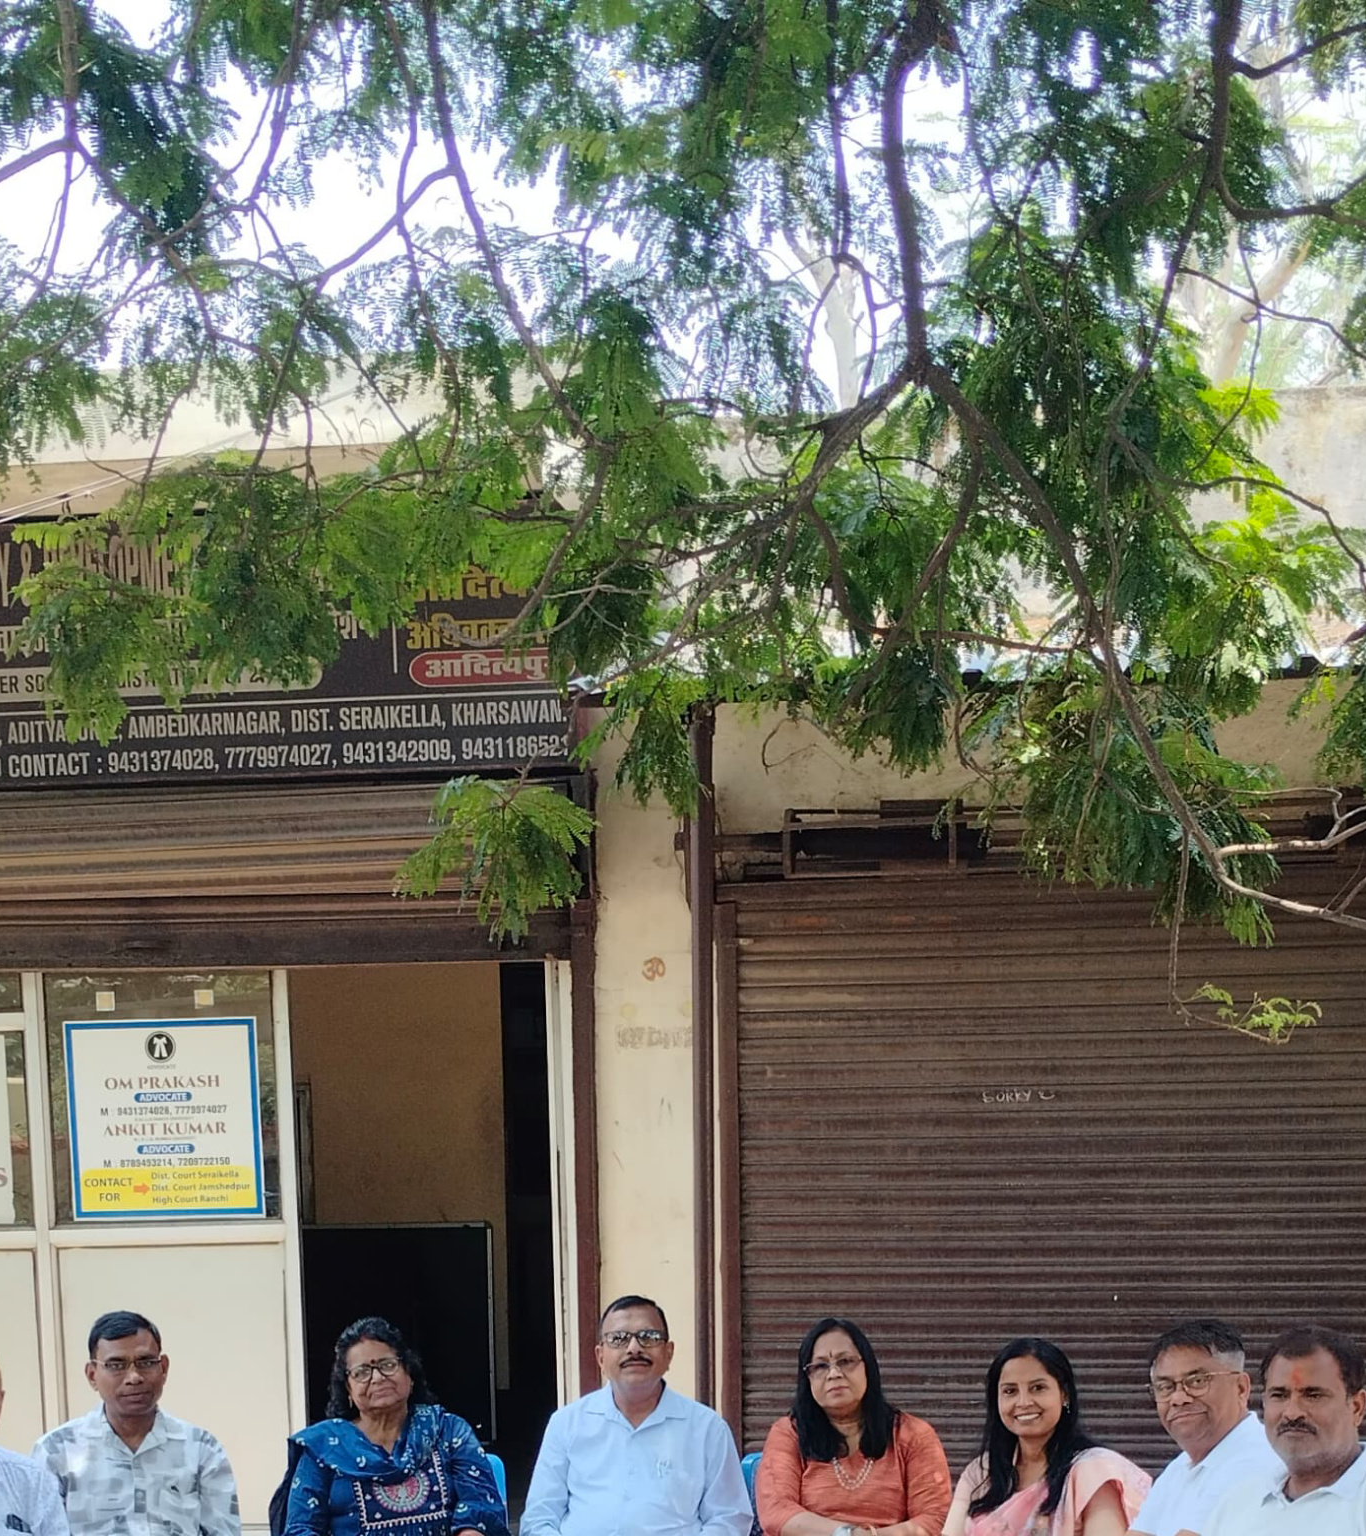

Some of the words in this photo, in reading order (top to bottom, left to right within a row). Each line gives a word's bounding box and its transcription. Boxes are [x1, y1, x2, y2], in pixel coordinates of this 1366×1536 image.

[128, 711, 286, 739] AMBEDKARNAGAR,
[291, 708, 334, 734] DIST.
[340, 704, 446, 731] SERAIKELLA,
[452, 700, 568, 726] KHARSAWAN.
[8, 752, 90, 778] CONTACT
[108, 748, 220, 773] 9431374028,
[225, 744, 337, 769] 7779974027,
[343, 739, 457, 764] 9431342909,
[105, 1077, 133, 1090] OM
[138, 1075, 220, 1090] PRAKASH
[139, 1093, 187, 1102] ADVOCATE
[100, 1107, 109, 1116] M
[103, 1124, 158, 1137] ANKIT
[163, 1122, 227, 1136] KUMAR
[142, 1145, 190, 1154] ADVOCATE
[172, 1171, 196, 1179] Court
[198, 1170, 239, 1178] Seraikella
[84, 1178, 133, 1188] CONTACT
[172, 1183, 196, 1191] Court
[198, 1182, 251, 1193] Jamshedpur
[99, 1193, 120, 1202] FOR
[152, 1195, 172, 1205] High
[174, 1195, 198, 1204] Court
[200, 1194, 229, 1203] Ranchi
